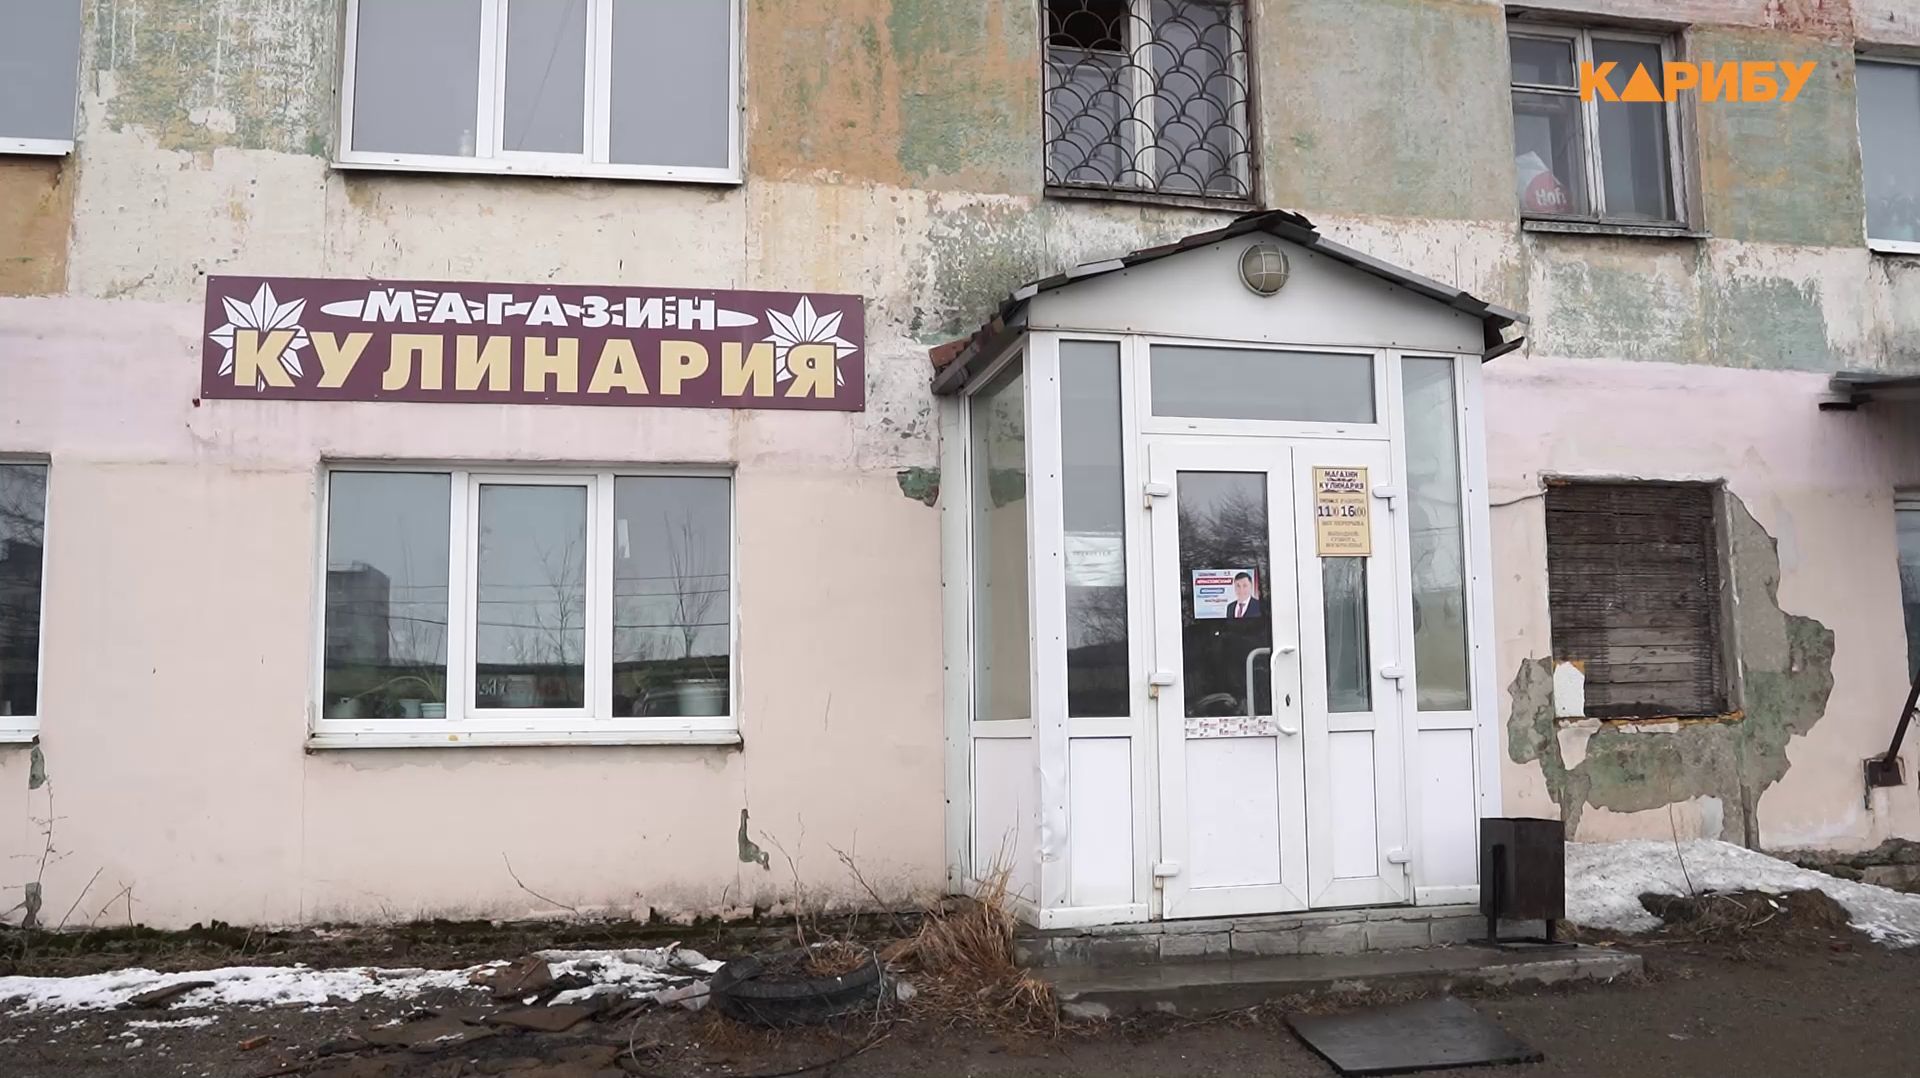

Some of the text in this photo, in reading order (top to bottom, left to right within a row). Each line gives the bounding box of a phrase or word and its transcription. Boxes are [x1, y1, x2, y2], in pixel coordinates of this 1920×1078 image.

[361, 288, 716, 331] МАГАЗИН
[233, 330, 837, 399] КУЛИНАРИЯ
[1319, 481, 1364, 490] КУЛИНАРИЯ
[1324, 470, 1358, 478] МАГАЗИН
